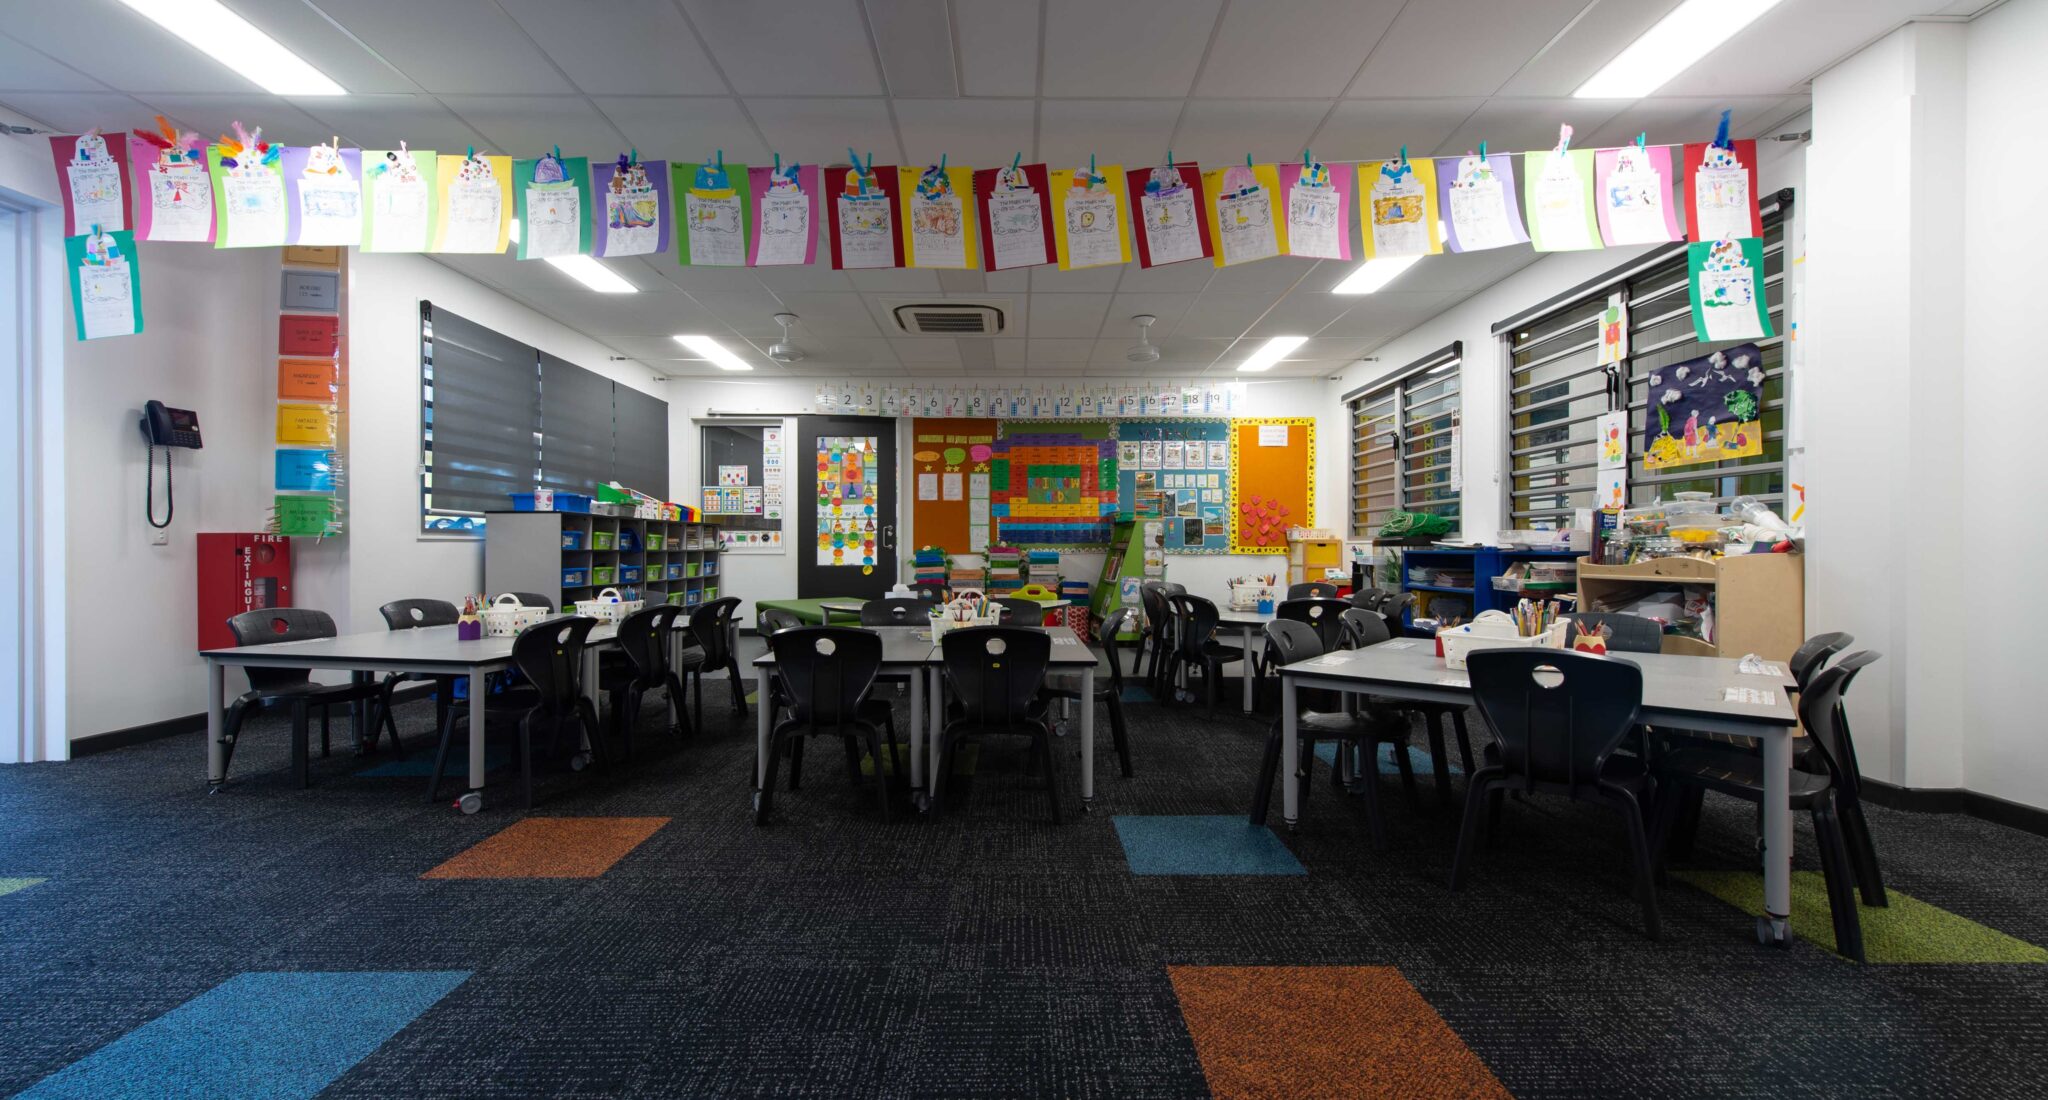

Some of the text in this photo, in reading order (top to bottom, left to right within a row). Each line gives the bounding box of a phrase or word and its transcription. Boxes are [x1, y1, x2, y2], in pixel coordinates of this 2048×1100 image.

[844, 394, 852, 405] 2
[865, 394, 873, 406] 3
[887, 394, 894, 406] 4
[909, 395, 916, 406] 5
[930, 396, 938, 408] 6
[952, 397, 960, 408] 7
[973, 397, 981, 408] 8
[995, 397, 1002, 408] 9
[1016, 396, 1026, 406] 10
[1037, 397, 1046, 408] 11
[1060, 397, 1070, 407] 12
[1080, 396, 1092, 406] 13
[1102, 396, 1112, 406] 14
[1124, 395, 1134, 406] 15
[1144, 396, 1156, 405] 16
[1166, 396, 1177, 406] 17
[1188, 394, 1199, 404] 18
[1210, 394, 1220, 404] 19
[1028, 477, 1081, 490] RAINBOW
[254, 534, 283, 542] FIRE
[244, 546, 252, 612] EXTINGUI
